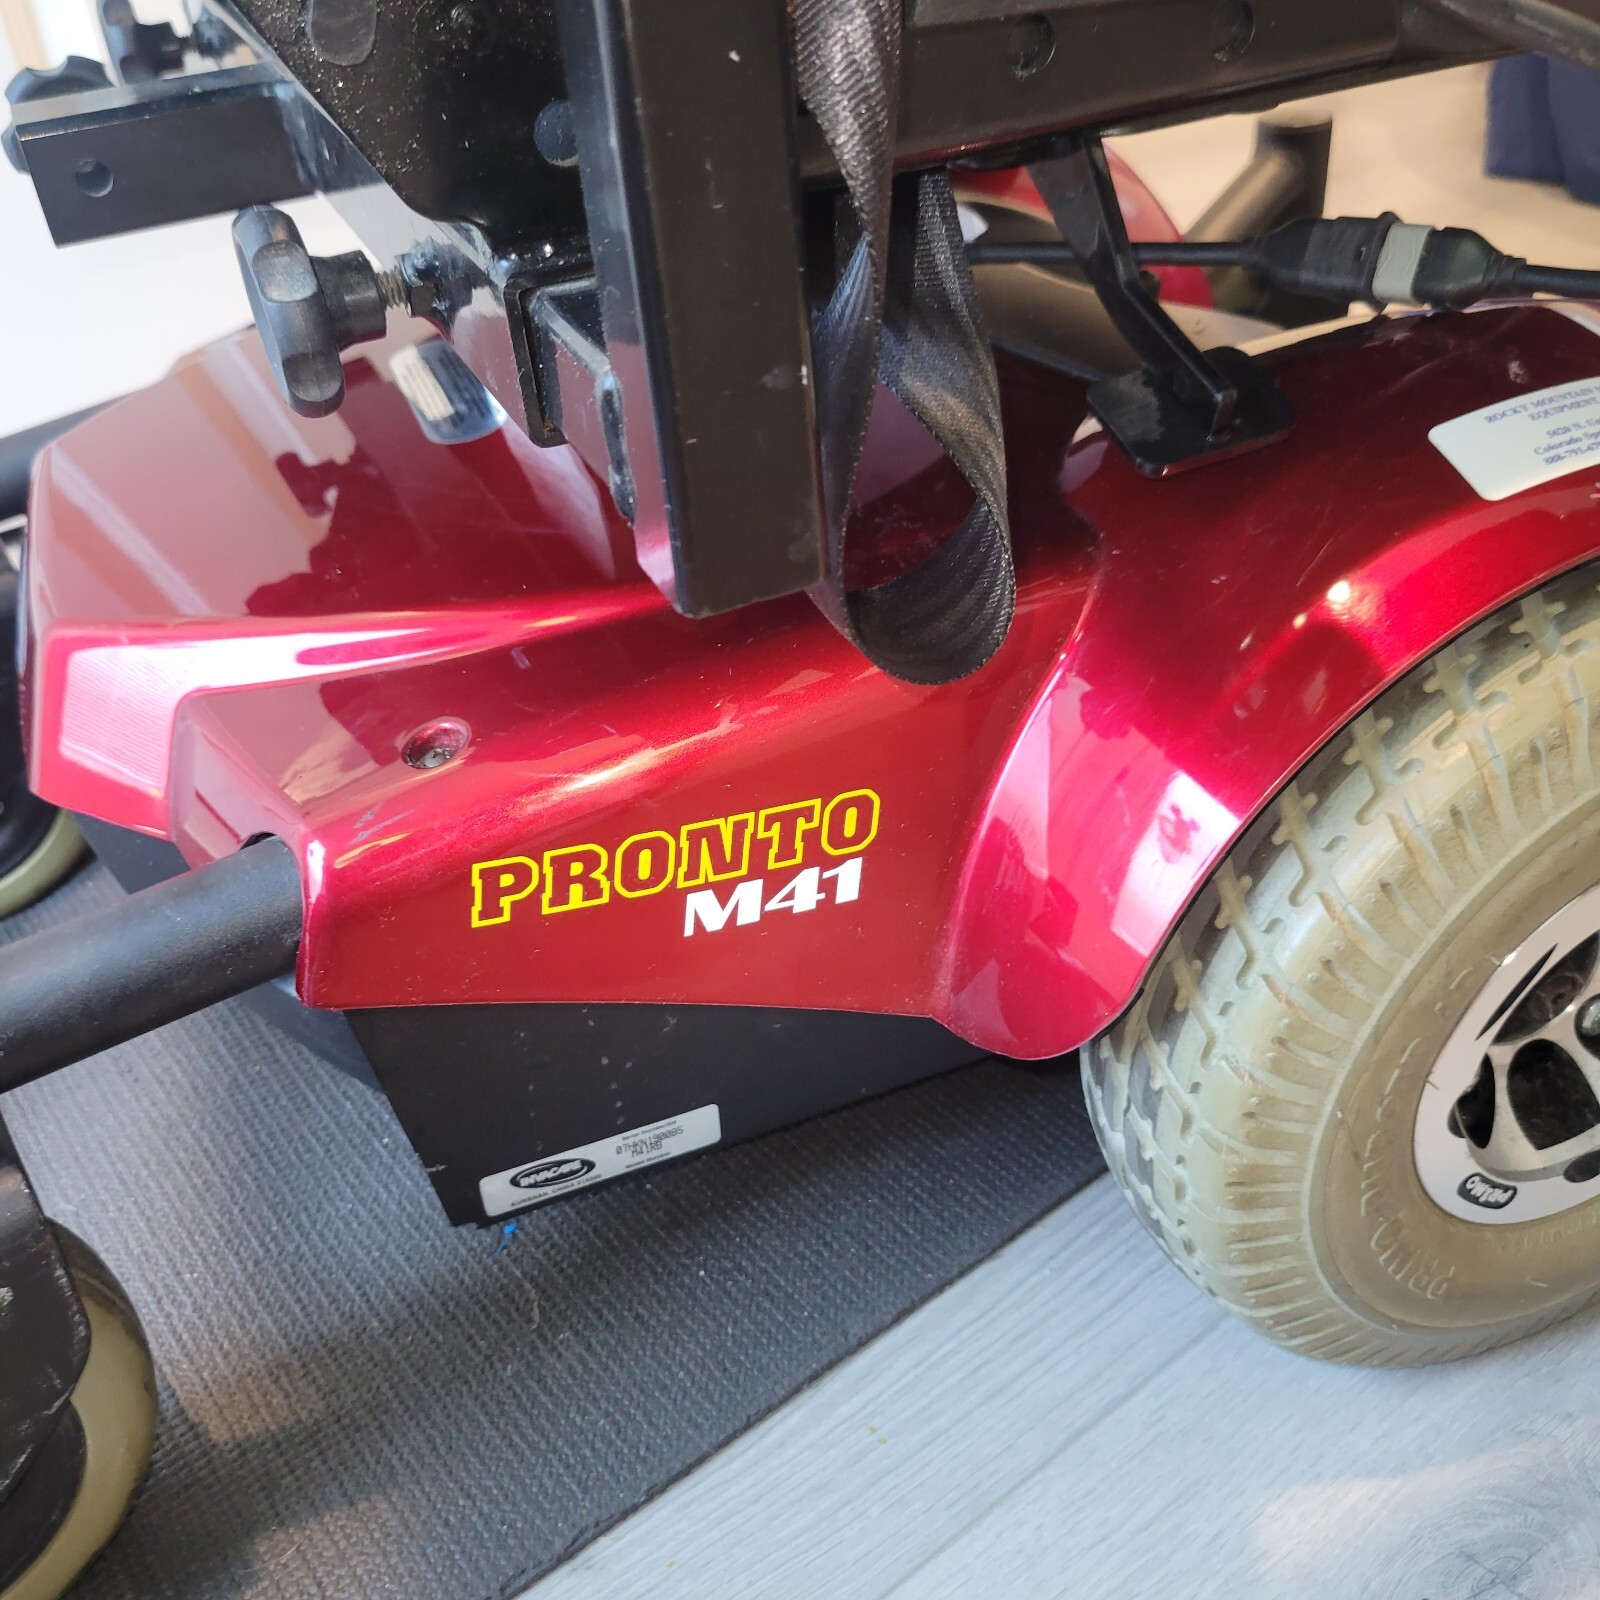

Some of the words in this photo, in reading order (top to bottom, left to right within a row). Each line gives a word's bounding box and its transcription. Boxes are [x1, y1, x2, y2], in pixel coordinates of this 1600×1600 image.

[1484, 403, 1530, 424] ROCKY
[1530, 386, 1594, 409] MOUNTAIN
[1533, 436, 1583, 456] Colorado
[471, 788, 881, 928] PRONTO
[683, 857, 864, 938] M41
[519, 1159, 582, 1187] INVACARE
